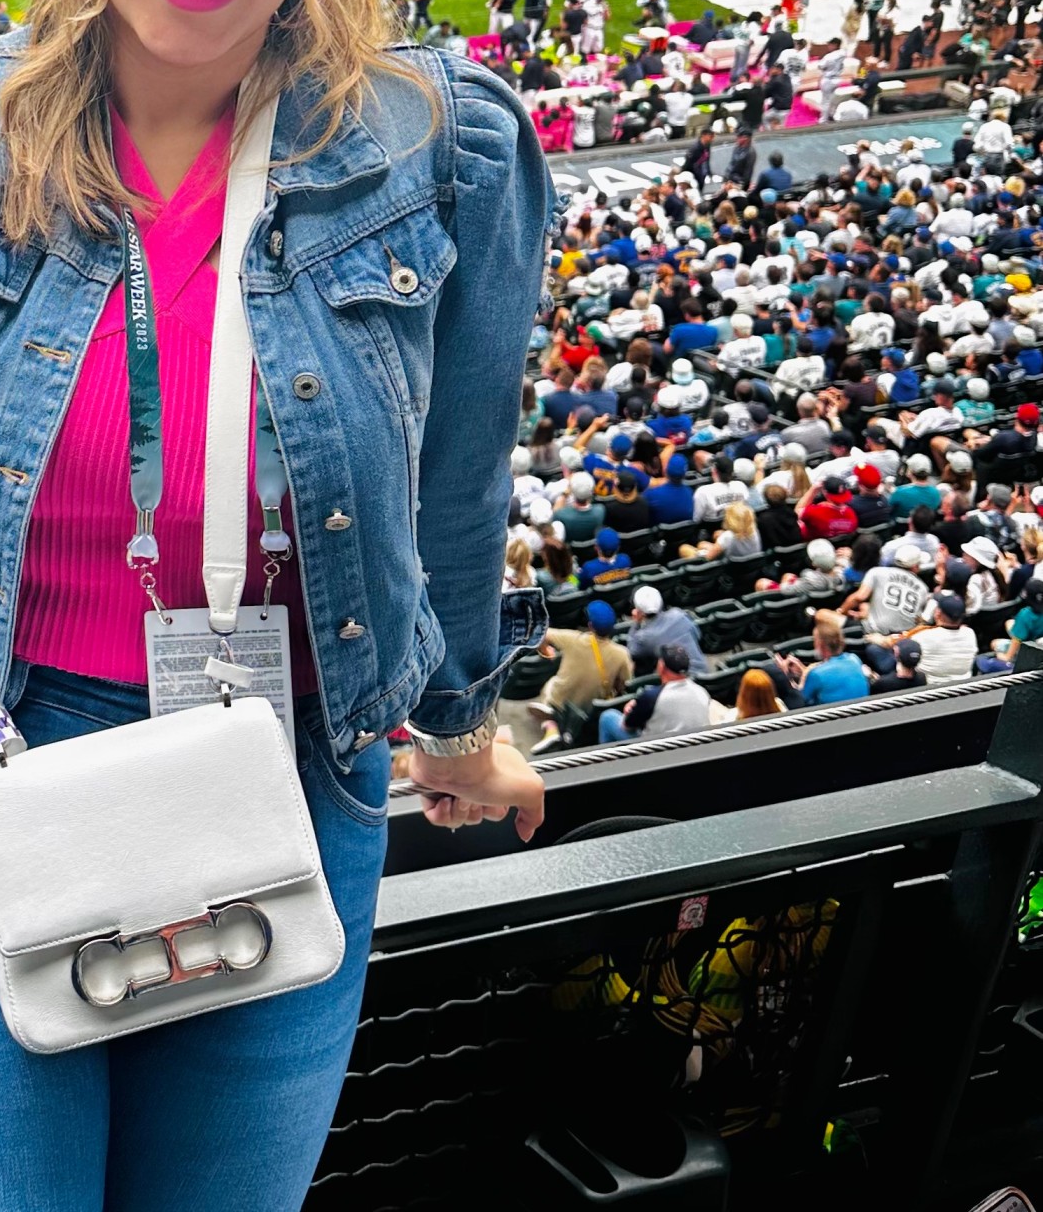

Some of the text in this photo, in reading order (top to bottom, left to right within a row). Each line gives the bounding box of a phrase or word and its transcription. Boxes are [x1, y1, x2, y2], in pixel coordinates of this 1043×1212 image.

[130, 272, 147, 322] WEEK
[135, 323, 148, 351] 2023
[884, 584, 919, 616] 99
